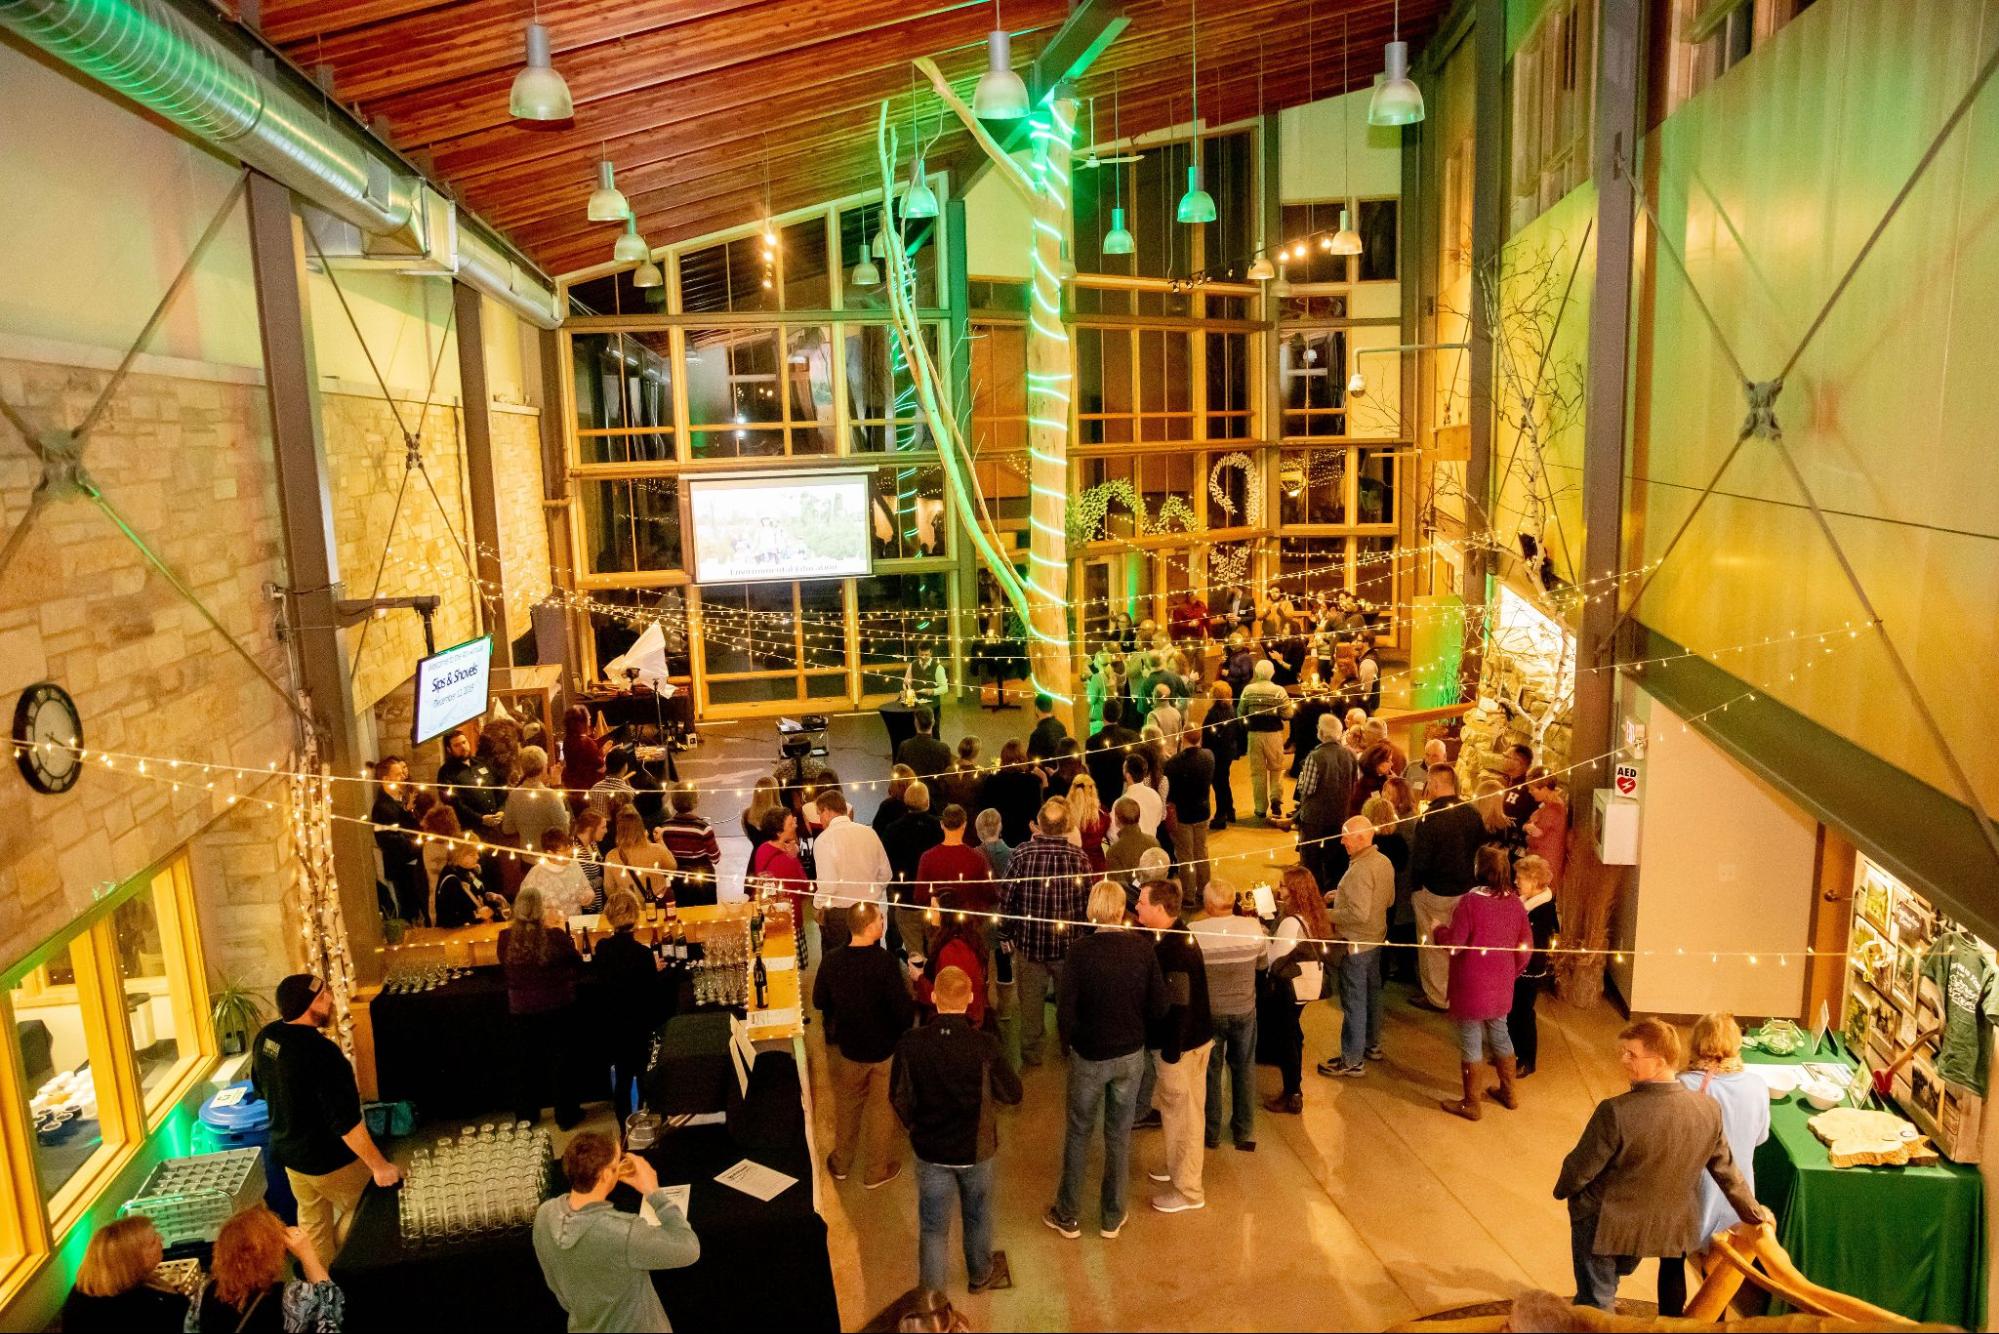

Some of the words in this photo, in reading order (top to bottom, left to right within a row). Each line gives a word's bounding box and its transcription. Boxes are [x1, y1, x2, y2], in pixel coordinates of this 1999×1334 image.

[432, 678, 445, 693] Sips
[446, 671, 454, 685] &
[454, 664, 478, 683] Shovels
[1617, 766, 1637, 777] AED
[1506, 791, 1519, 804] H
